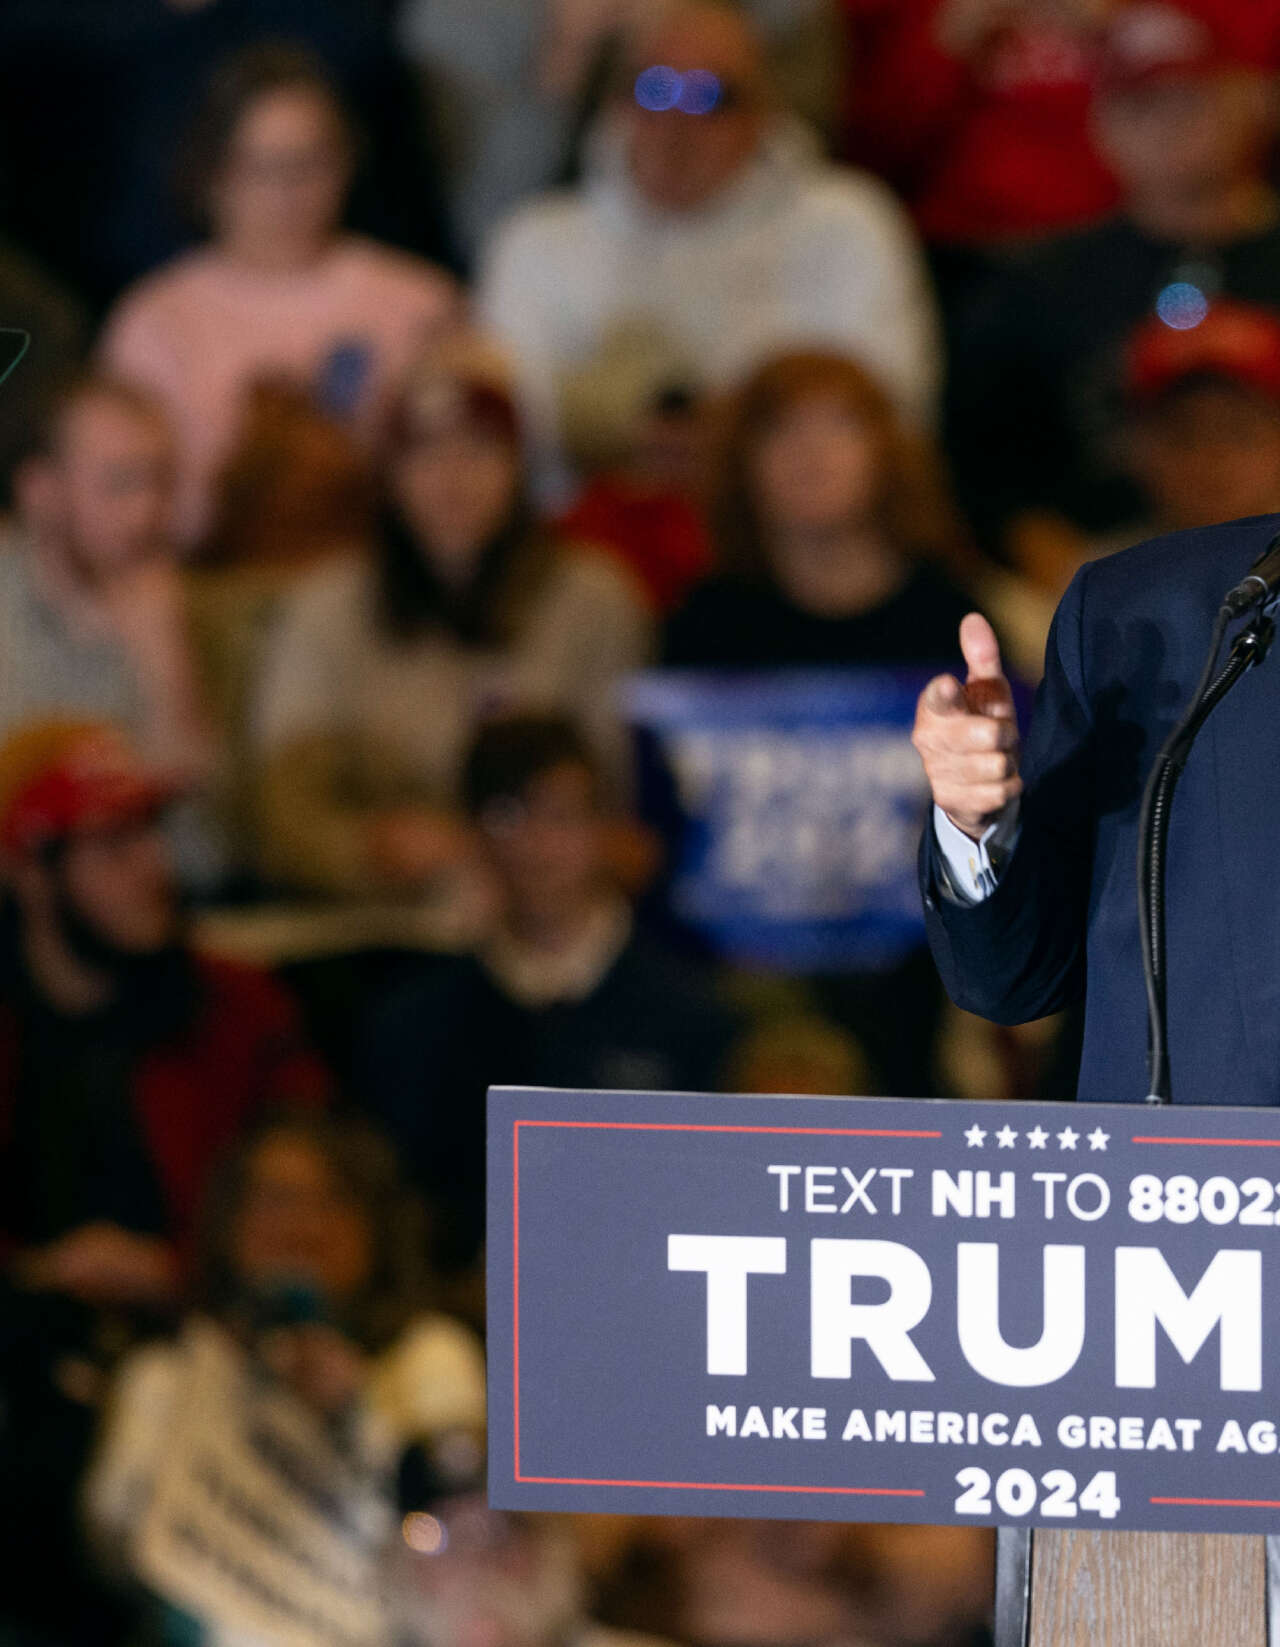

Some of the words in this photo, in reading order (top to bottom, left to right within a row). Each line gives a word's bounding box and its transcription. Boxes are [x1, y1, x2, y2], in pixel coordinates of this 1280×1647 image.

[767, 1164, 914, 1216] TEXT
[931, 1169, 1016, 1219] NH
[1031, 1172, 1111, 1222] TO
[705, 1403, 827, 1440] MAKE
[841, 1408, 1042, 1448] AMERICA
[1057, 1414, 1202, 1453] GREAT
[953, 1466, 1121, 1519] 2024
